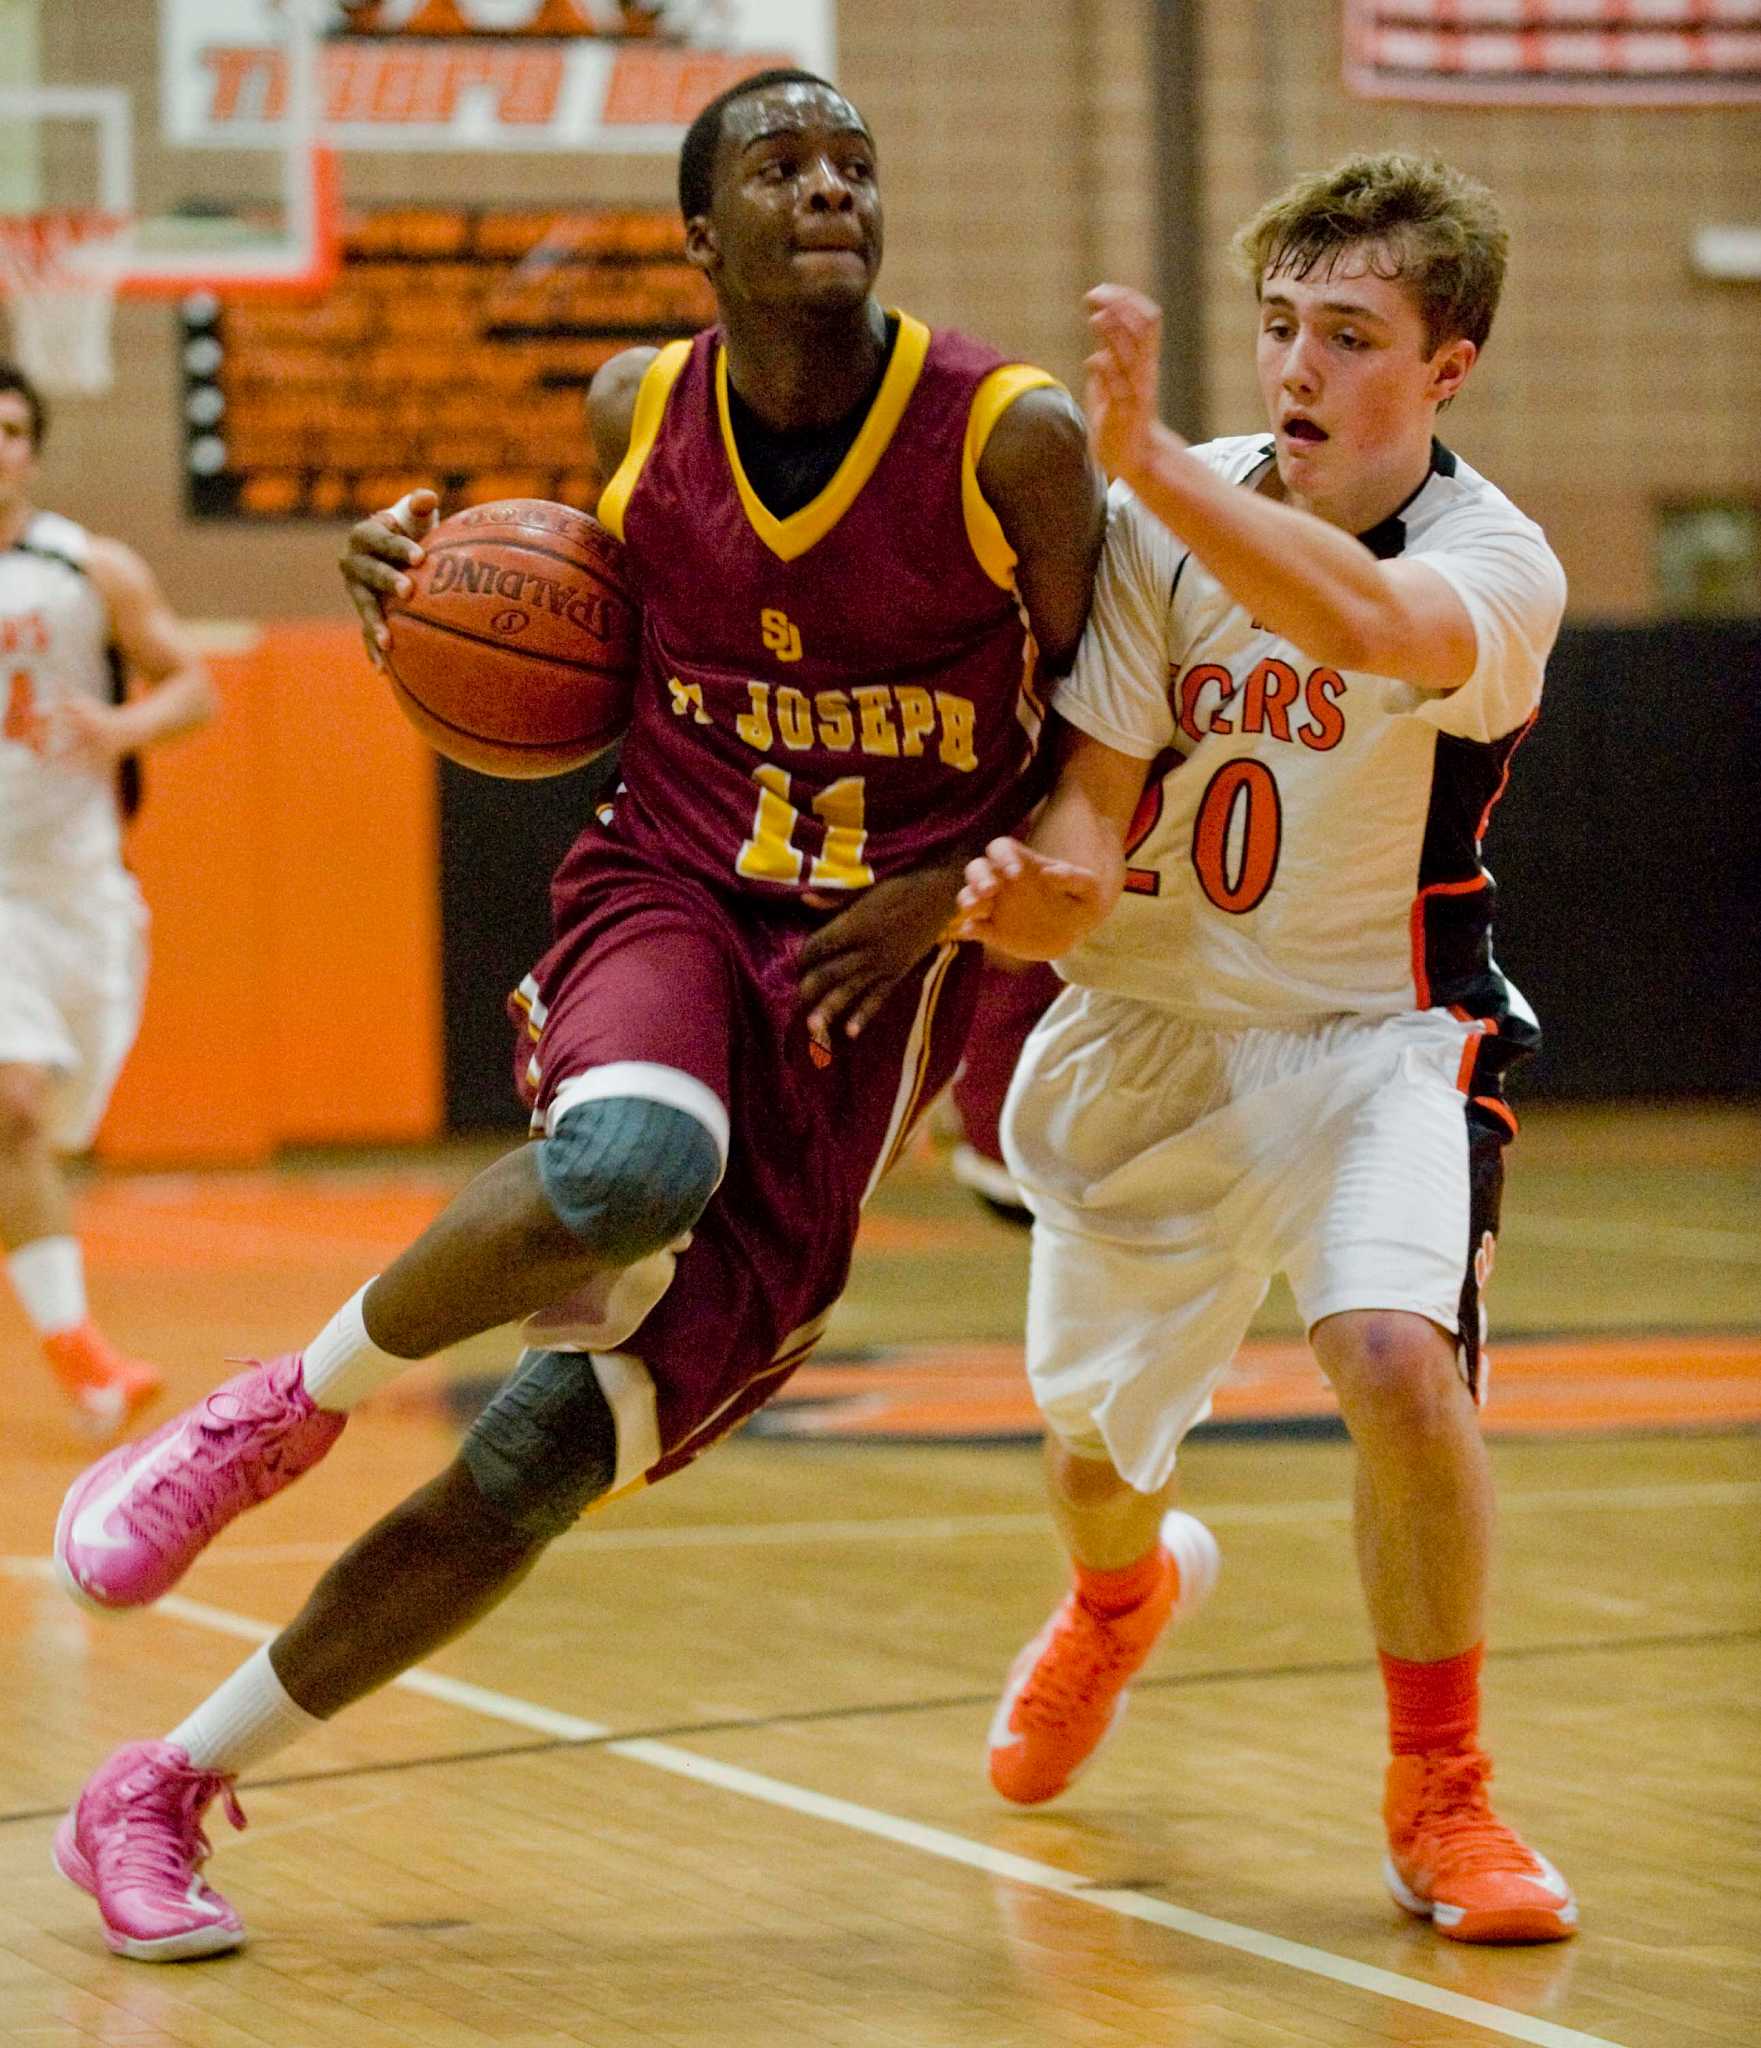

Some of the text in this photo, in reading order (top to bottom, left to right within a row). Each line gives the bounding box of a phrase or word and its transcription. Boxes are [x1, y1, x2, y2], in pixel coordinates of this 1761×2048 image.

[429, 556, 619, 643] SPALDING
[735, 680, 979, 773] JOSEPH
[735, 763, 875, 890] 11
